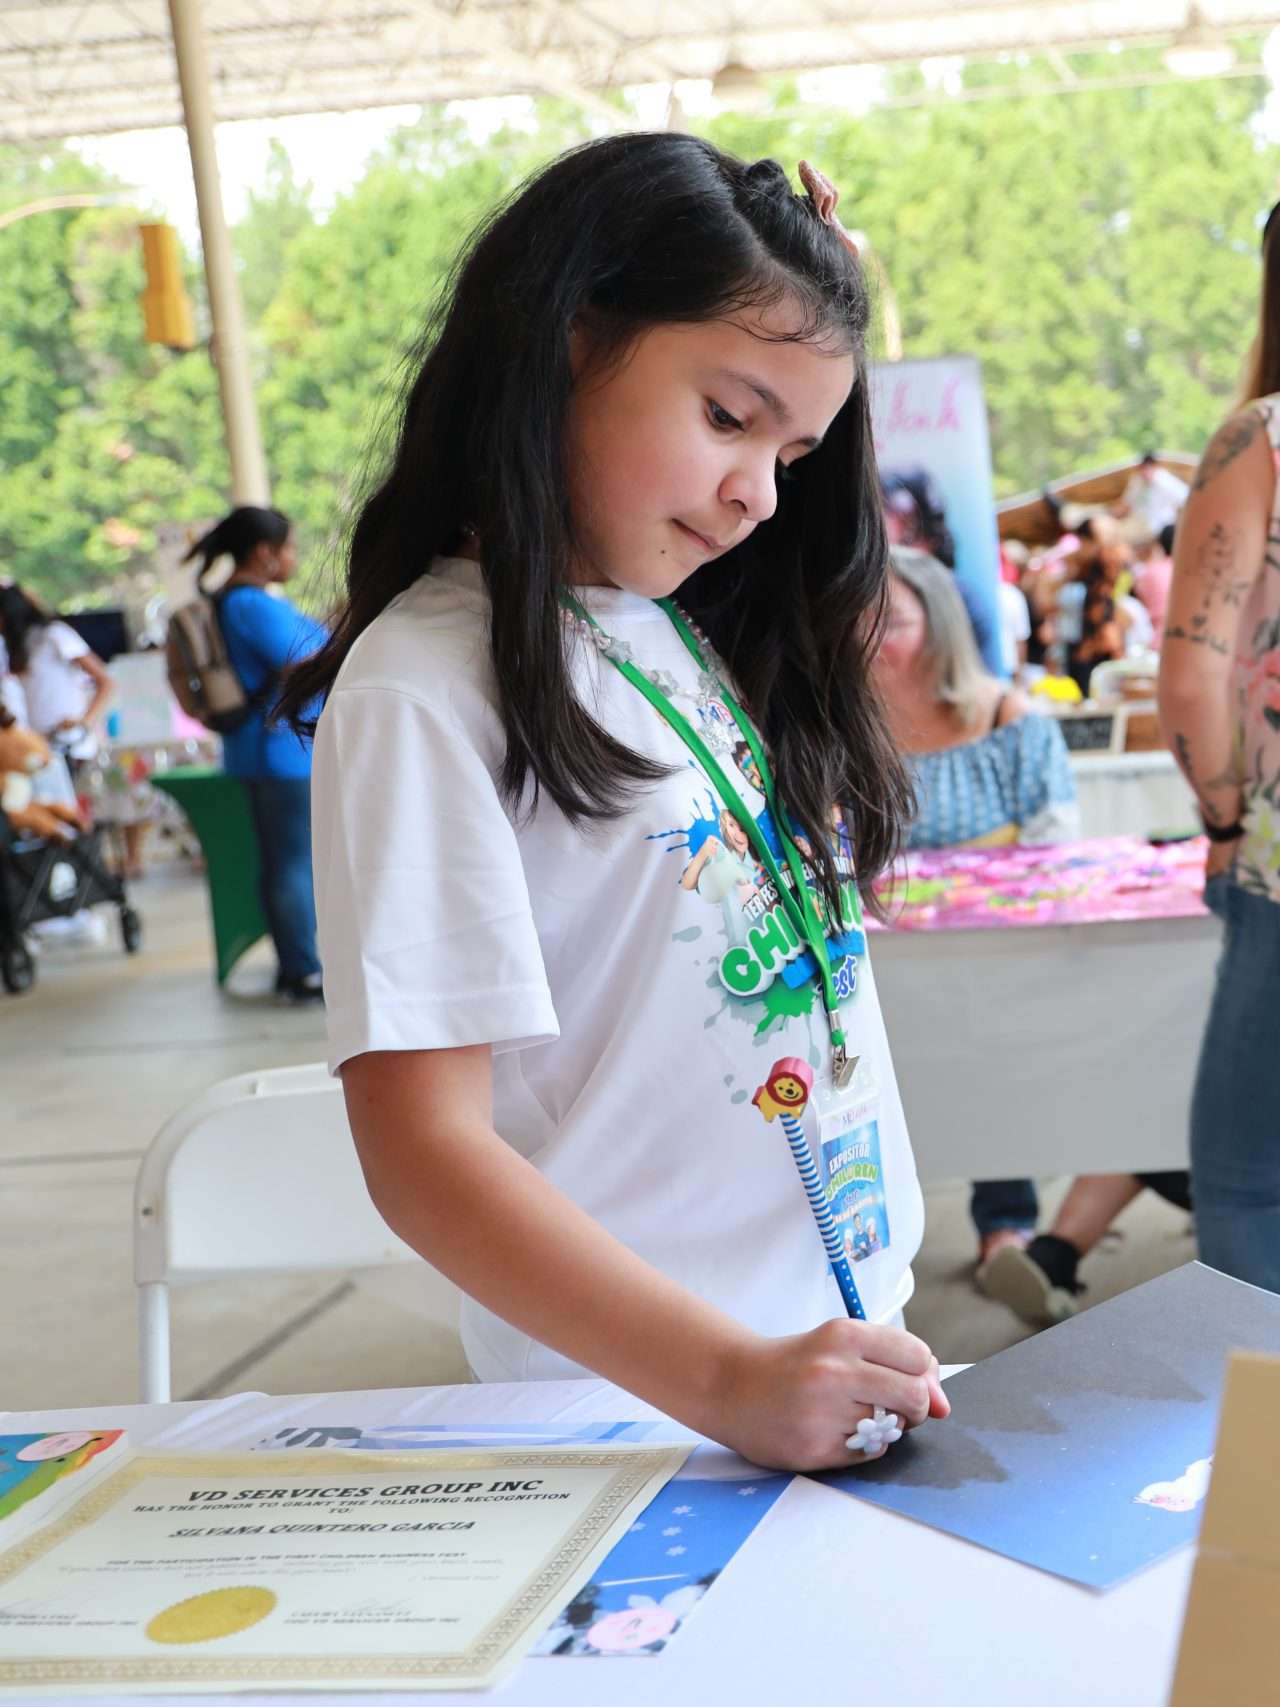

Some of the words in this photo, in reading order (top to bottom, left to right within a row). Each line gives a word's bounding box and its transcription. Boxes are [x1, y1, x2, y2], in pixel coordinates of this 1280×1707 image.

[829, 1142, 870, 1175] EXPOSITOR
[827, 1162, 879, 1202] CHILDREN
[188, 1490, 228, 1502] VD
[232, 1487, 374, 1501] SERVICES
[379, 1482, 484, 1497] GROUP
[488, 1480, 544, 1492] INC
[168, 1504, 197, 1512] THE
[200, 1502, 253, 1510] HONOR
[282, 1500, 334, 1508] GRANT
[371, 1496, 461, 1506] FOLLOWING
[464, 1493, 572, 1503] RECOGNITION
[167, 1524, 266, 1538] SILVANA
[268, 1523, 388, 1535] QUINTERO
[390, 1521, 477, 1532] GARCIA
